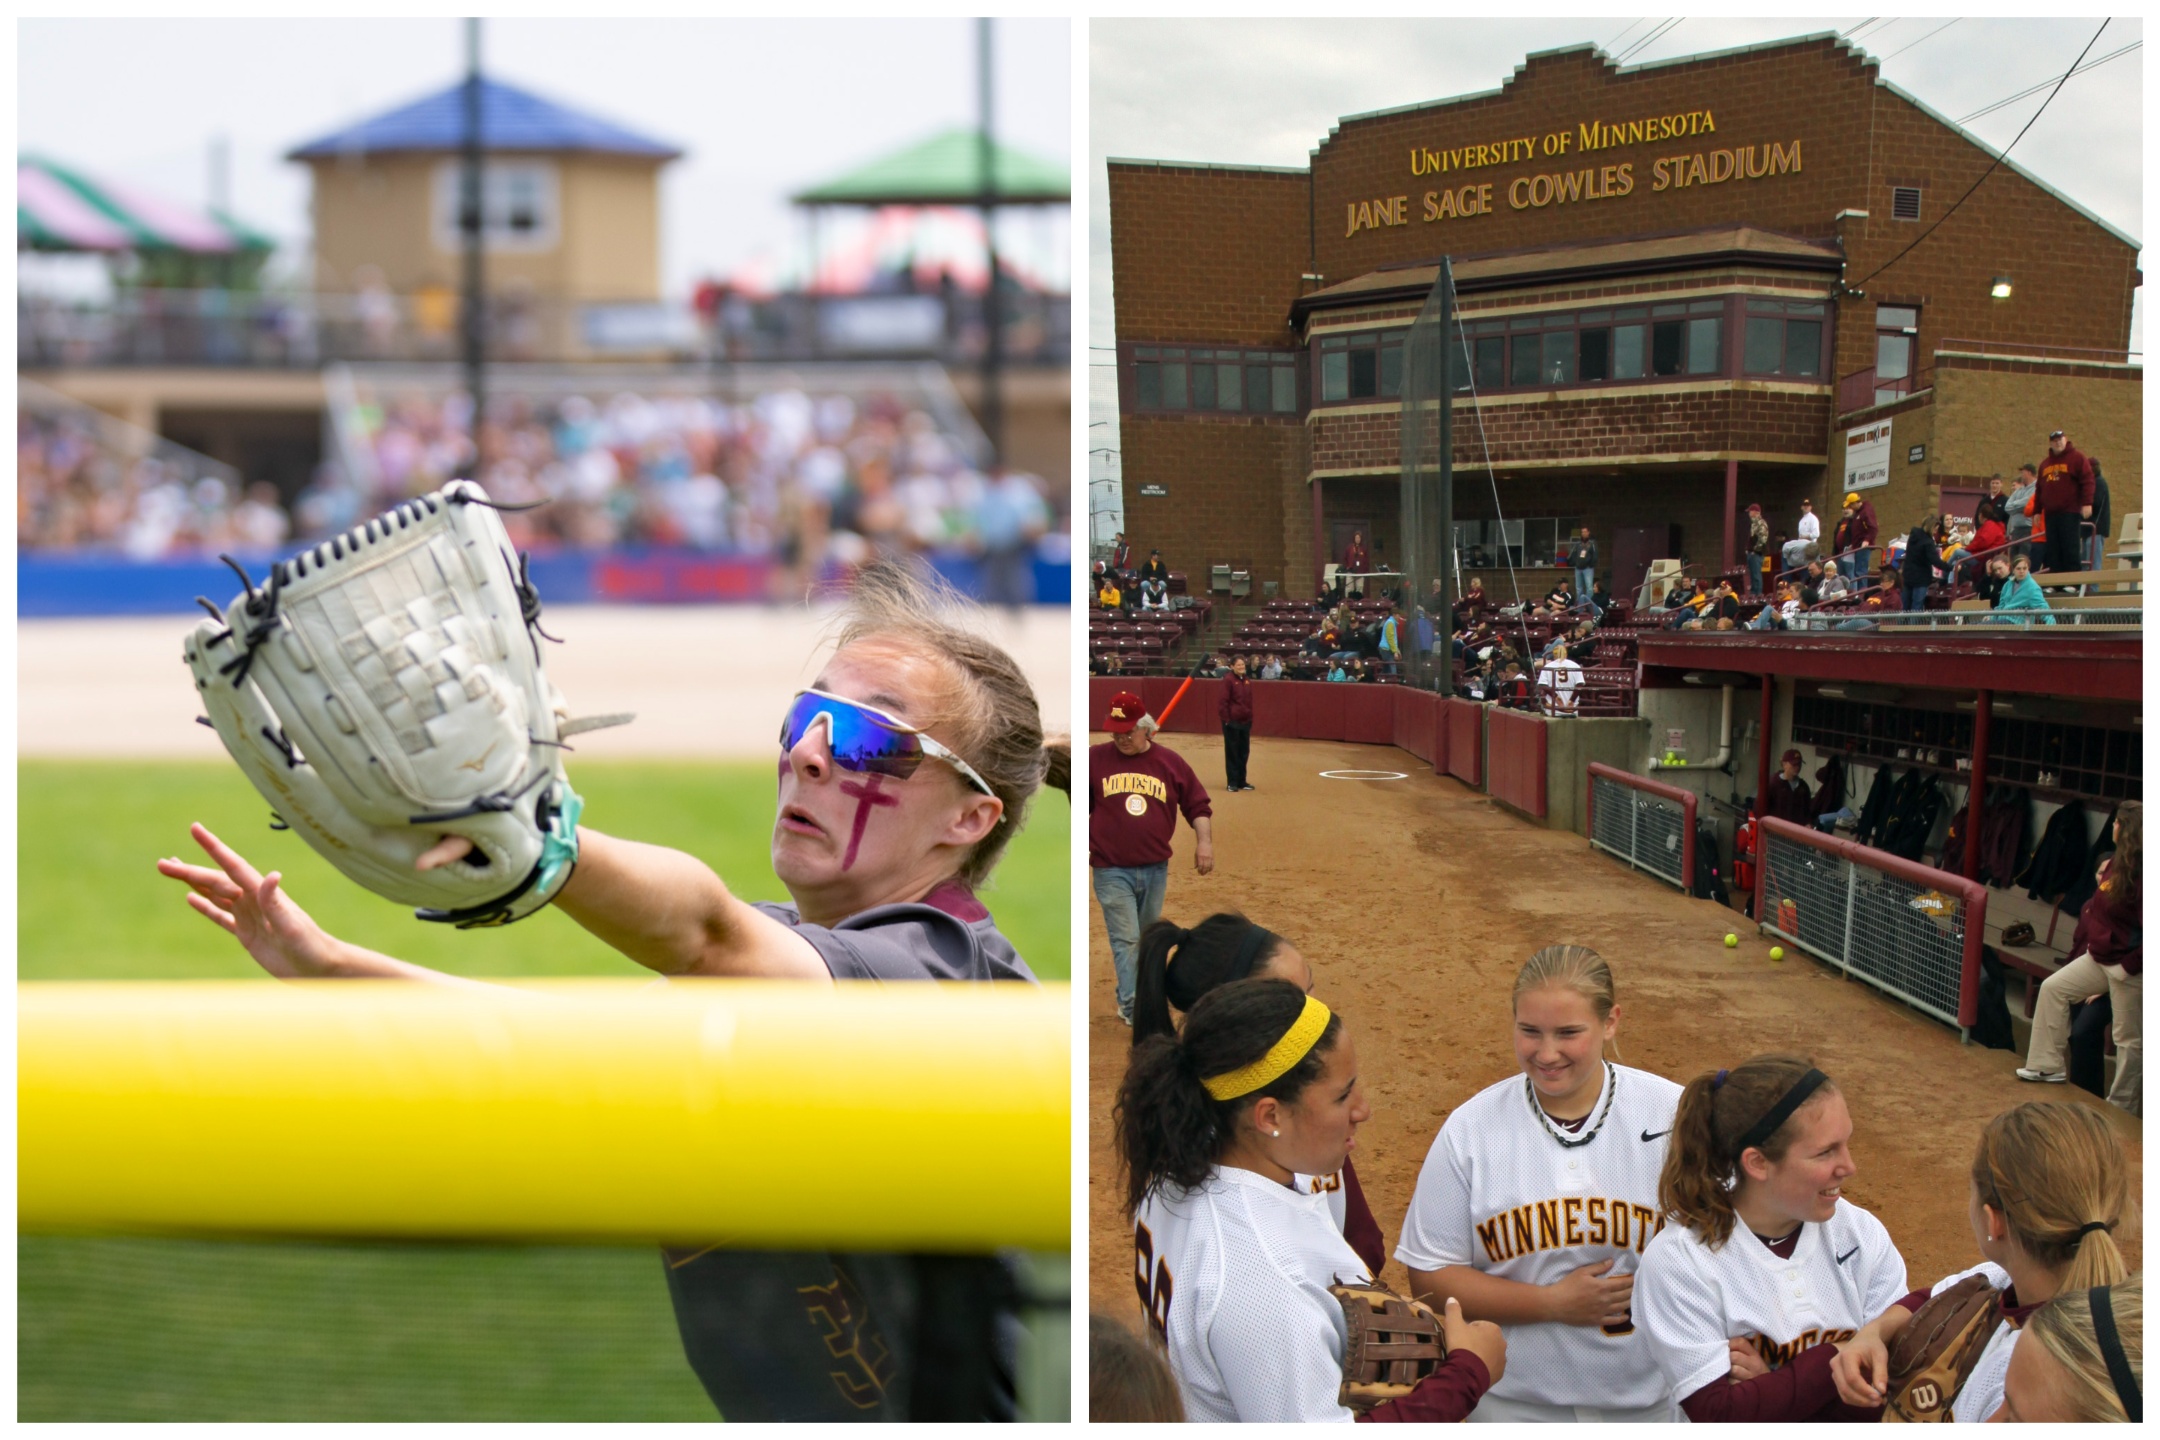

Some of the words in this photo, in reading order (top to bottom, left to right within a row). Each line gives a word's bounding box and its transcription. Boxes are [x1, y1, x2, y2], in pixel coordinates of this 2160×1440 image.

[1410, 136, 1537, 177] UNIVERSITY
[1543, 129, 1572, 156] OF
[1578, 109, 1716, 152] MINNESOTA
[1345, 195, 1408, 238] JANE
[1423, 183, 1493, 223] SAGE
[1507, 163, 1634, 210] COWLES
[1652, 140, 1802, 192] STADIUM
[1558, 667, 1569, 683] 9
[1102, 772, 1167, 803] MINNESOTA
